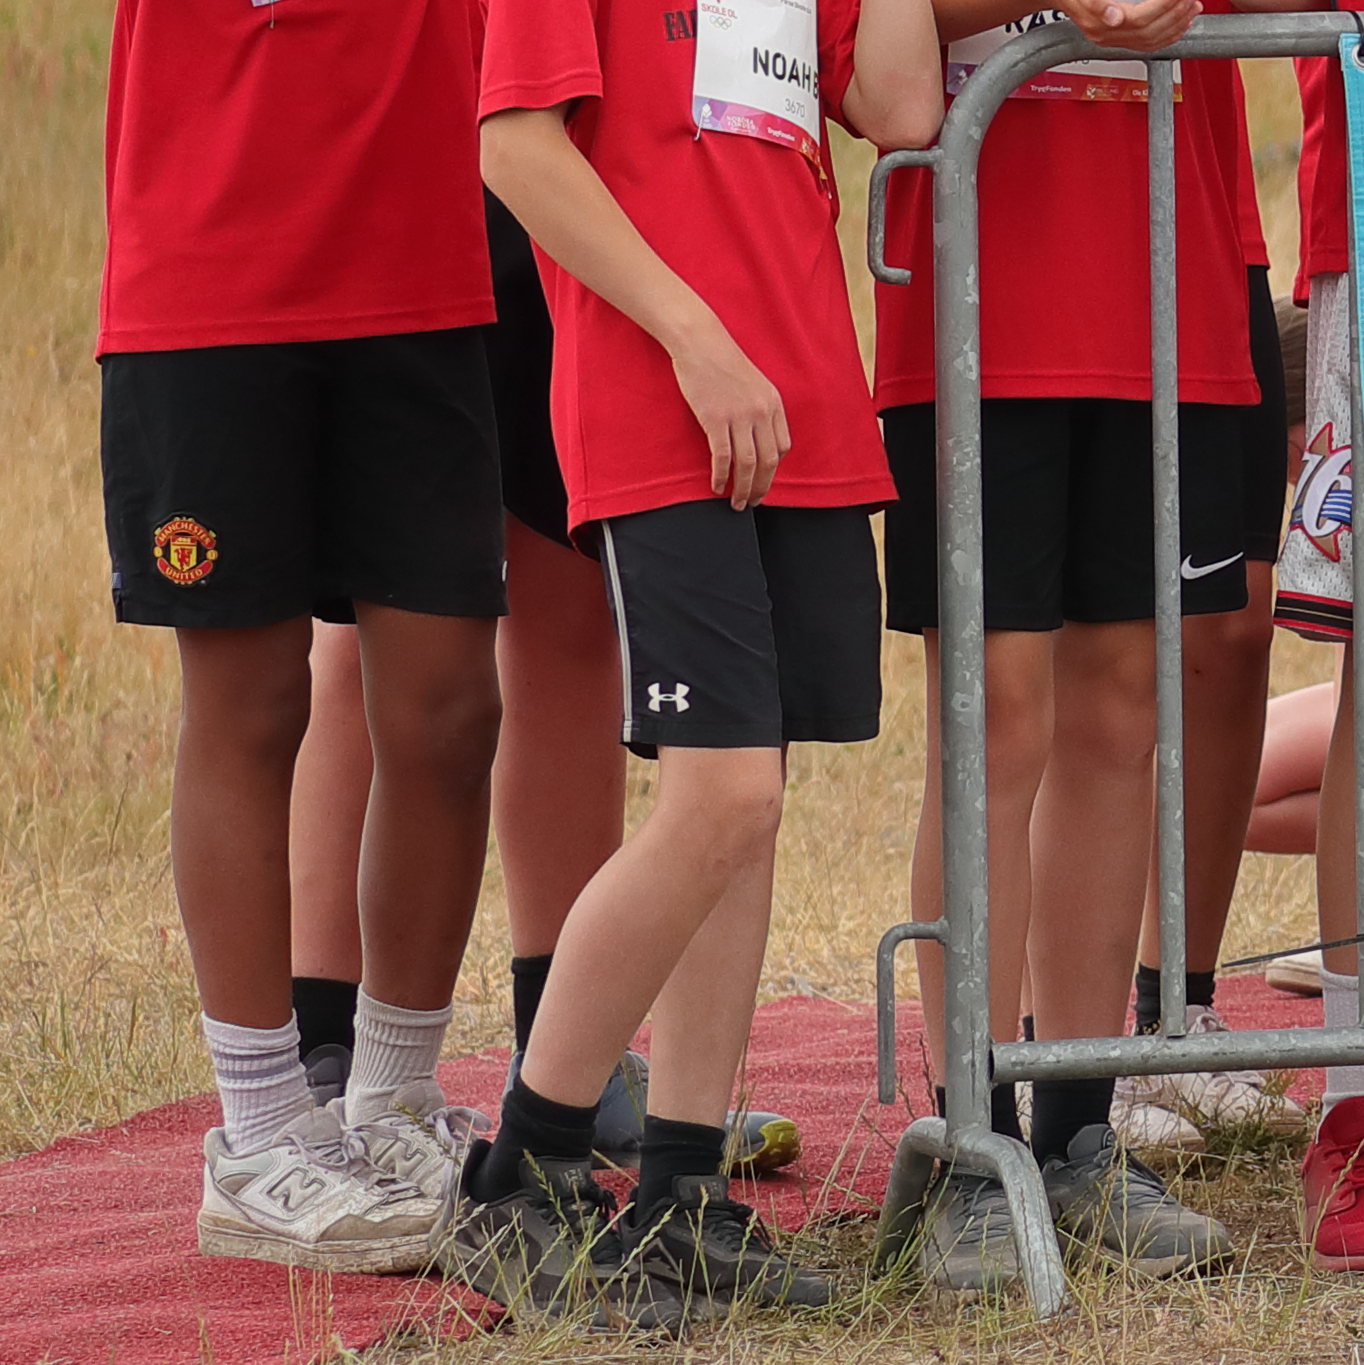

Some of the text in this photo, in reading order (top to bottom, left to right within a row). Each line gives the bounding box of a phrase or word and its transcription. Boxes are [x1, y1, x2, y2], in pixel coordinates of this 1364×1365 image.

[701, 3, 726, 16] SKOLE
[753, 47, 811, 93] NOAH
[785, 98, 806, 118] 3670
[158, 521, 212, 545] MANCHESTER
[165, 567, 203, 580] UNITED
